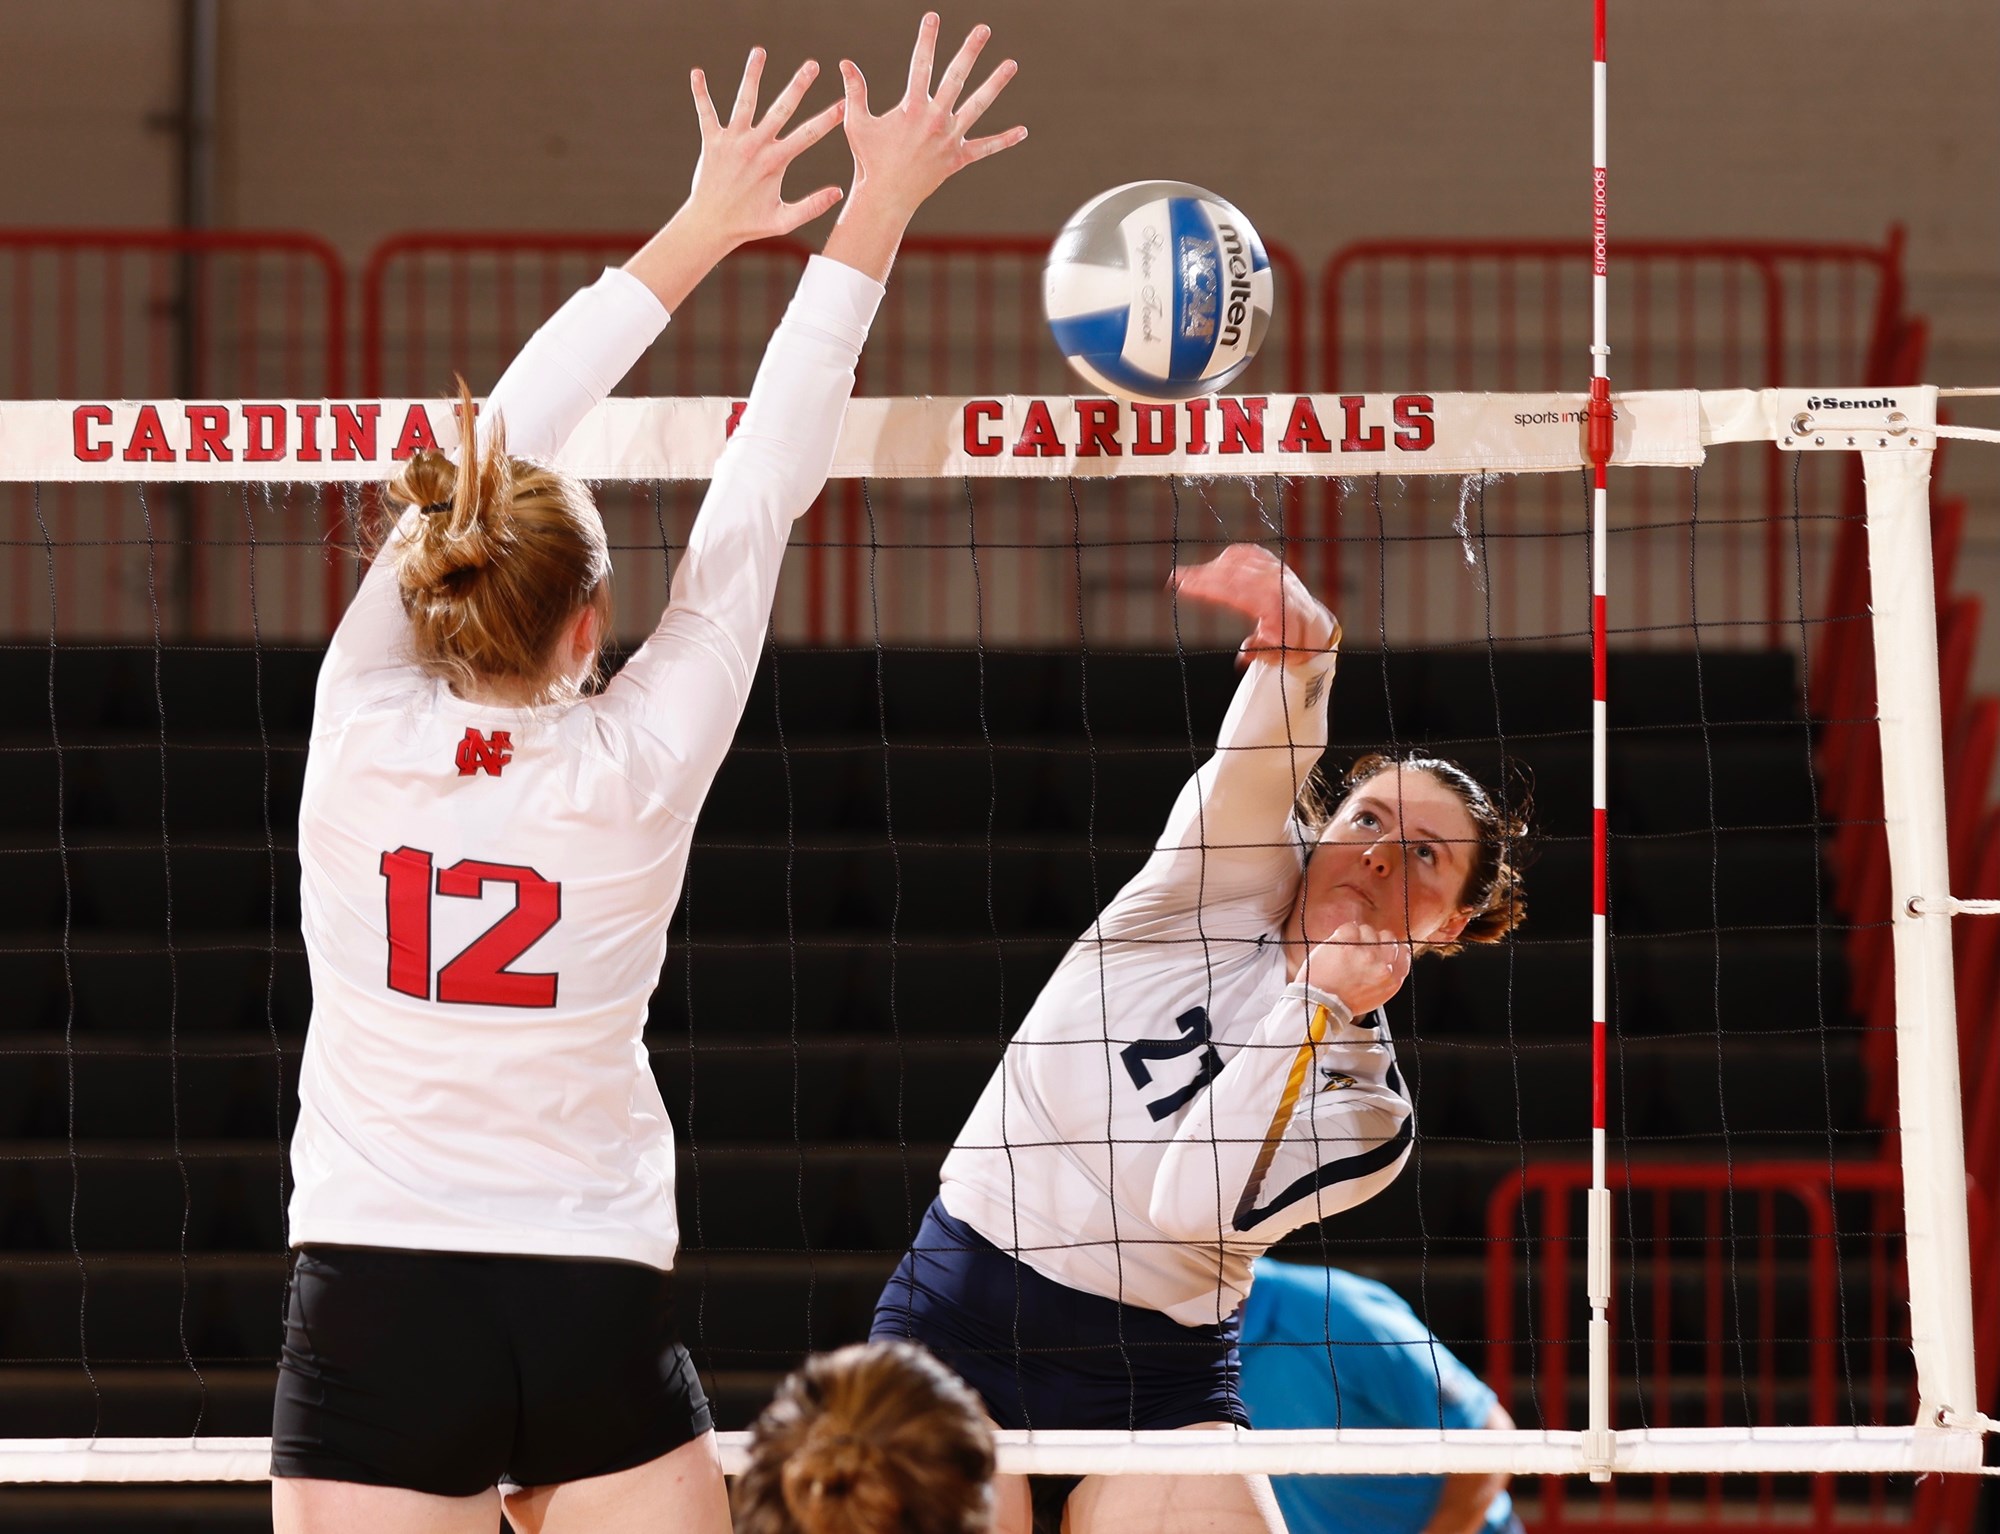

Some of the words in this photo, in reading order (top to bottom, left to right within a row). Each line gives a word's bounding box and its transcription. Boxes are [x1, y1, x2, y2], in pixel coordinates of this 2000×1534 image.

[1594, 170, 1606, 216] sports
[1218, 224, 1252, 346] molten
[73, 403, 479, 463] CARDINA
[963, 395, 1436, 458] CARDINALS
[1514, 411, 1559, 427] sports
[1562, 410, 1619, 425] imps
[1822, 397, 1897, 410] Senoh
[380, 845, 562, 1008] 12
